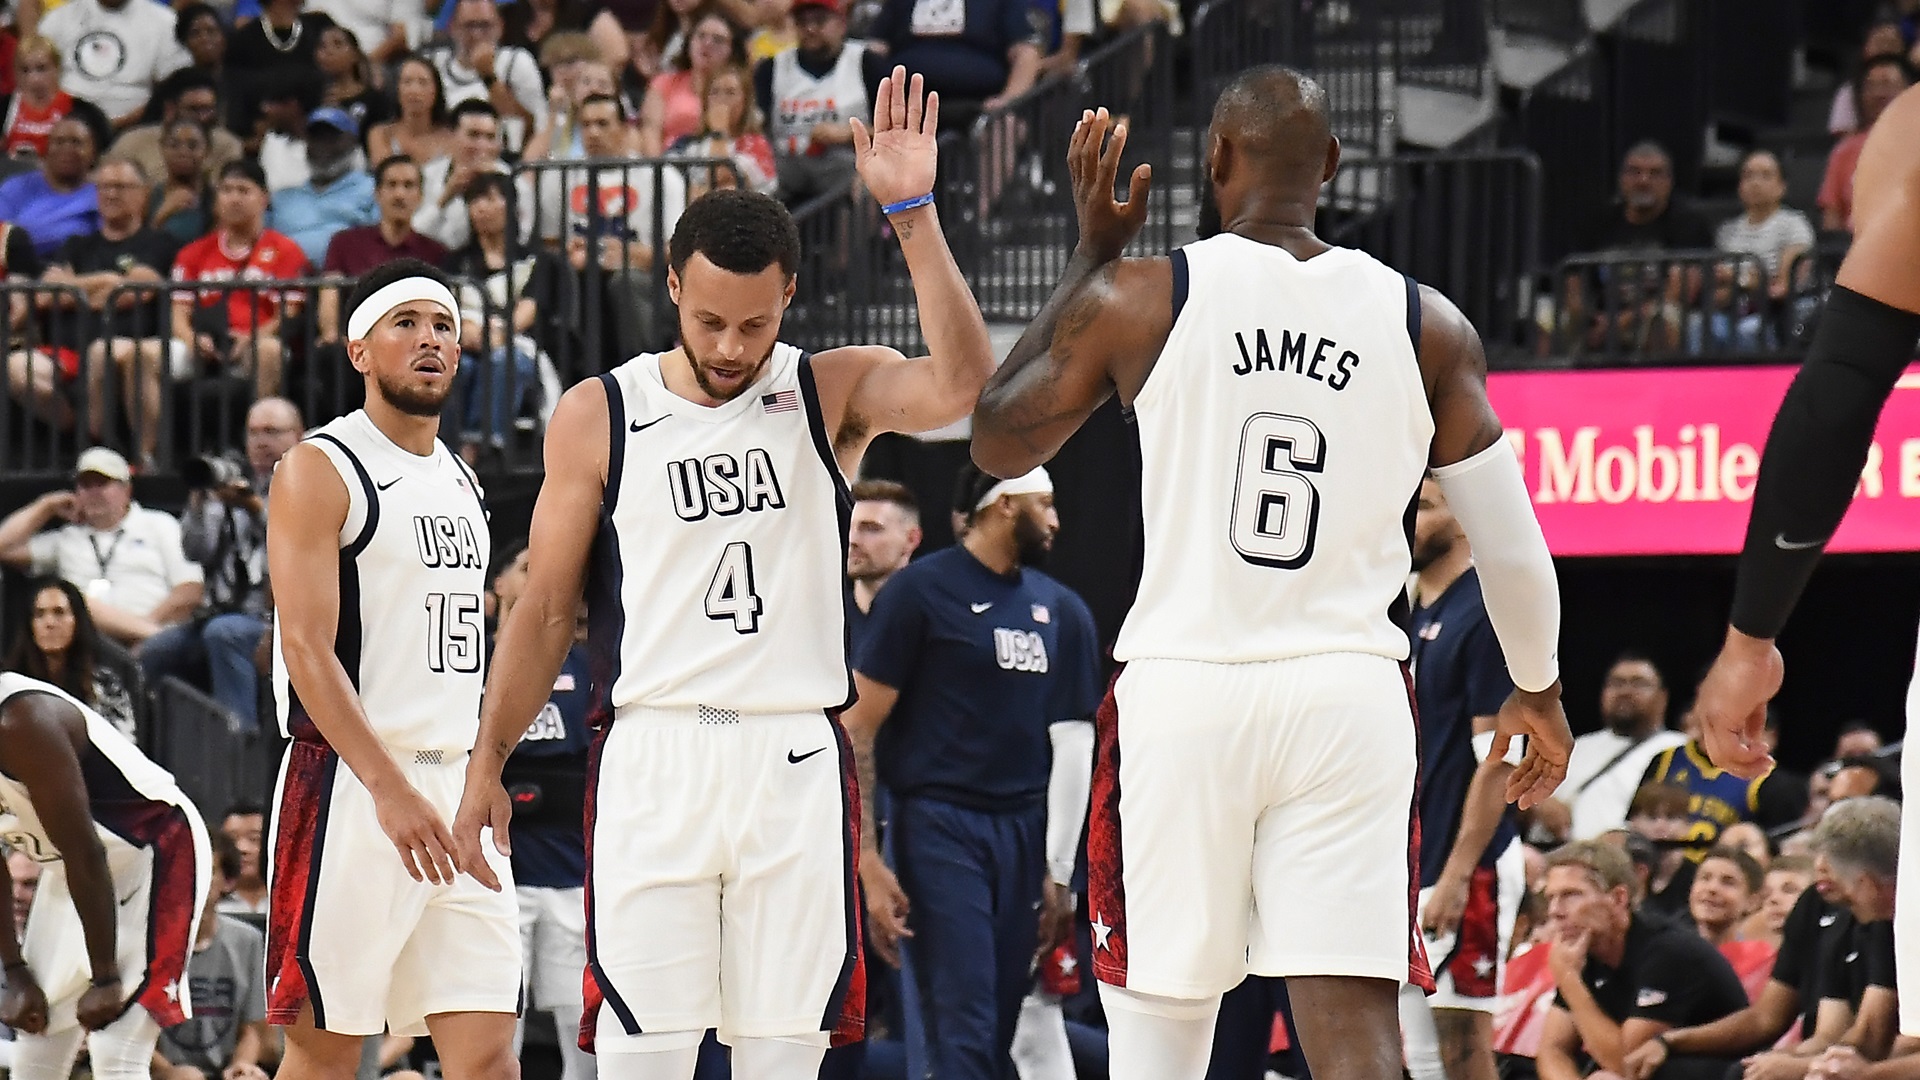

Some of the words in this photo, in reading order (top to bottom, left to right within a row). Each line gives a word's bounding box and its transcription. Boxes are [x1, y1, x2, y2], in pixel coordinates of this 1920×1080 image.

[1232, 328, 1360, 391] JAMES
[667, 448, 786, 522] USA
[1229, 411, 1327, 570] 6
[1535, 423, 1760, 504] Mobile
[413, 515, 482, 569] USA
[704, 541, 763, 634] 4
[425, 593, 480, 673] 15
[993, 628, 1049, 673] USA
